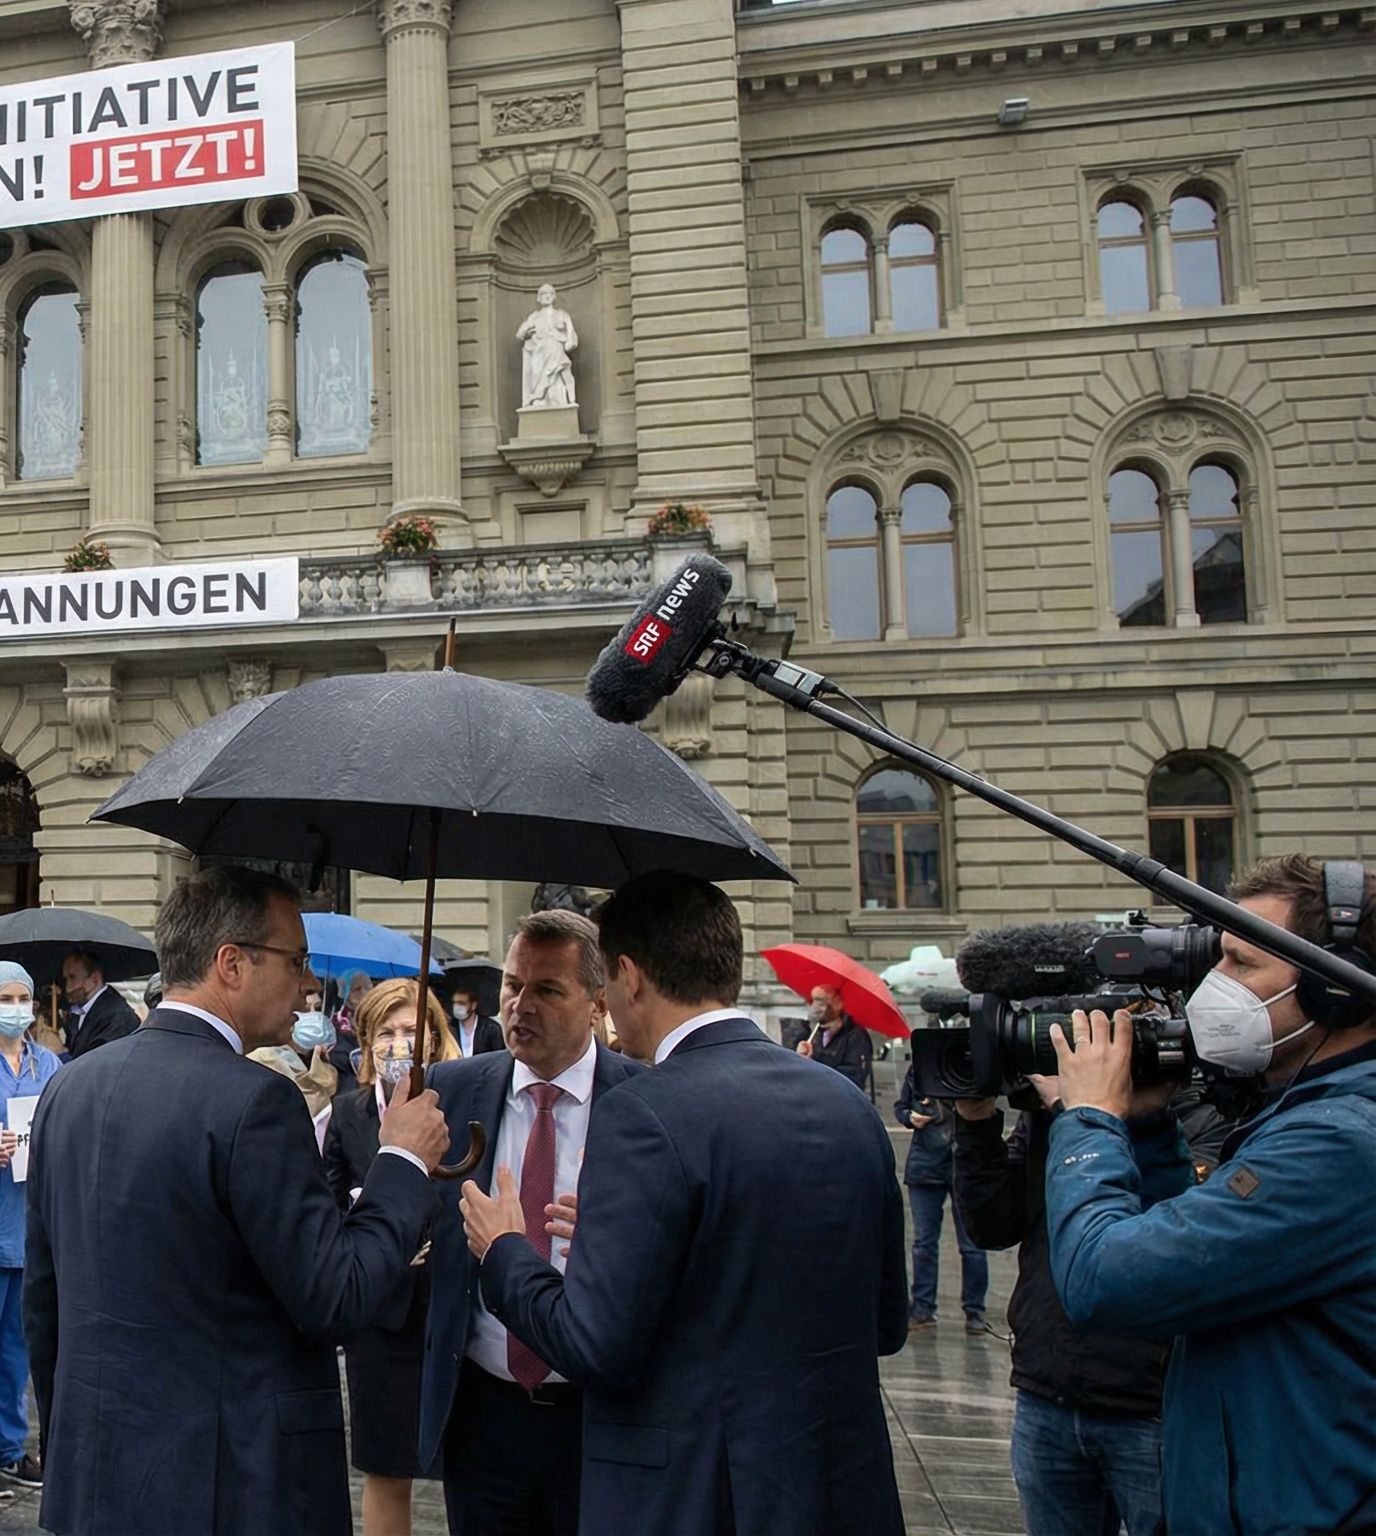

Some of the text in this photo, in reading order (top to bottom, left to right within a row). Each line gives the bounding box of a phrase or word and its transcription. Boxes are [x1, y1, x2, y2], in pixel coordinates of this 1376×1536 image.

[77, 128, 257, 192] JETZT!
[633, 568, 700, 656] SRF news
